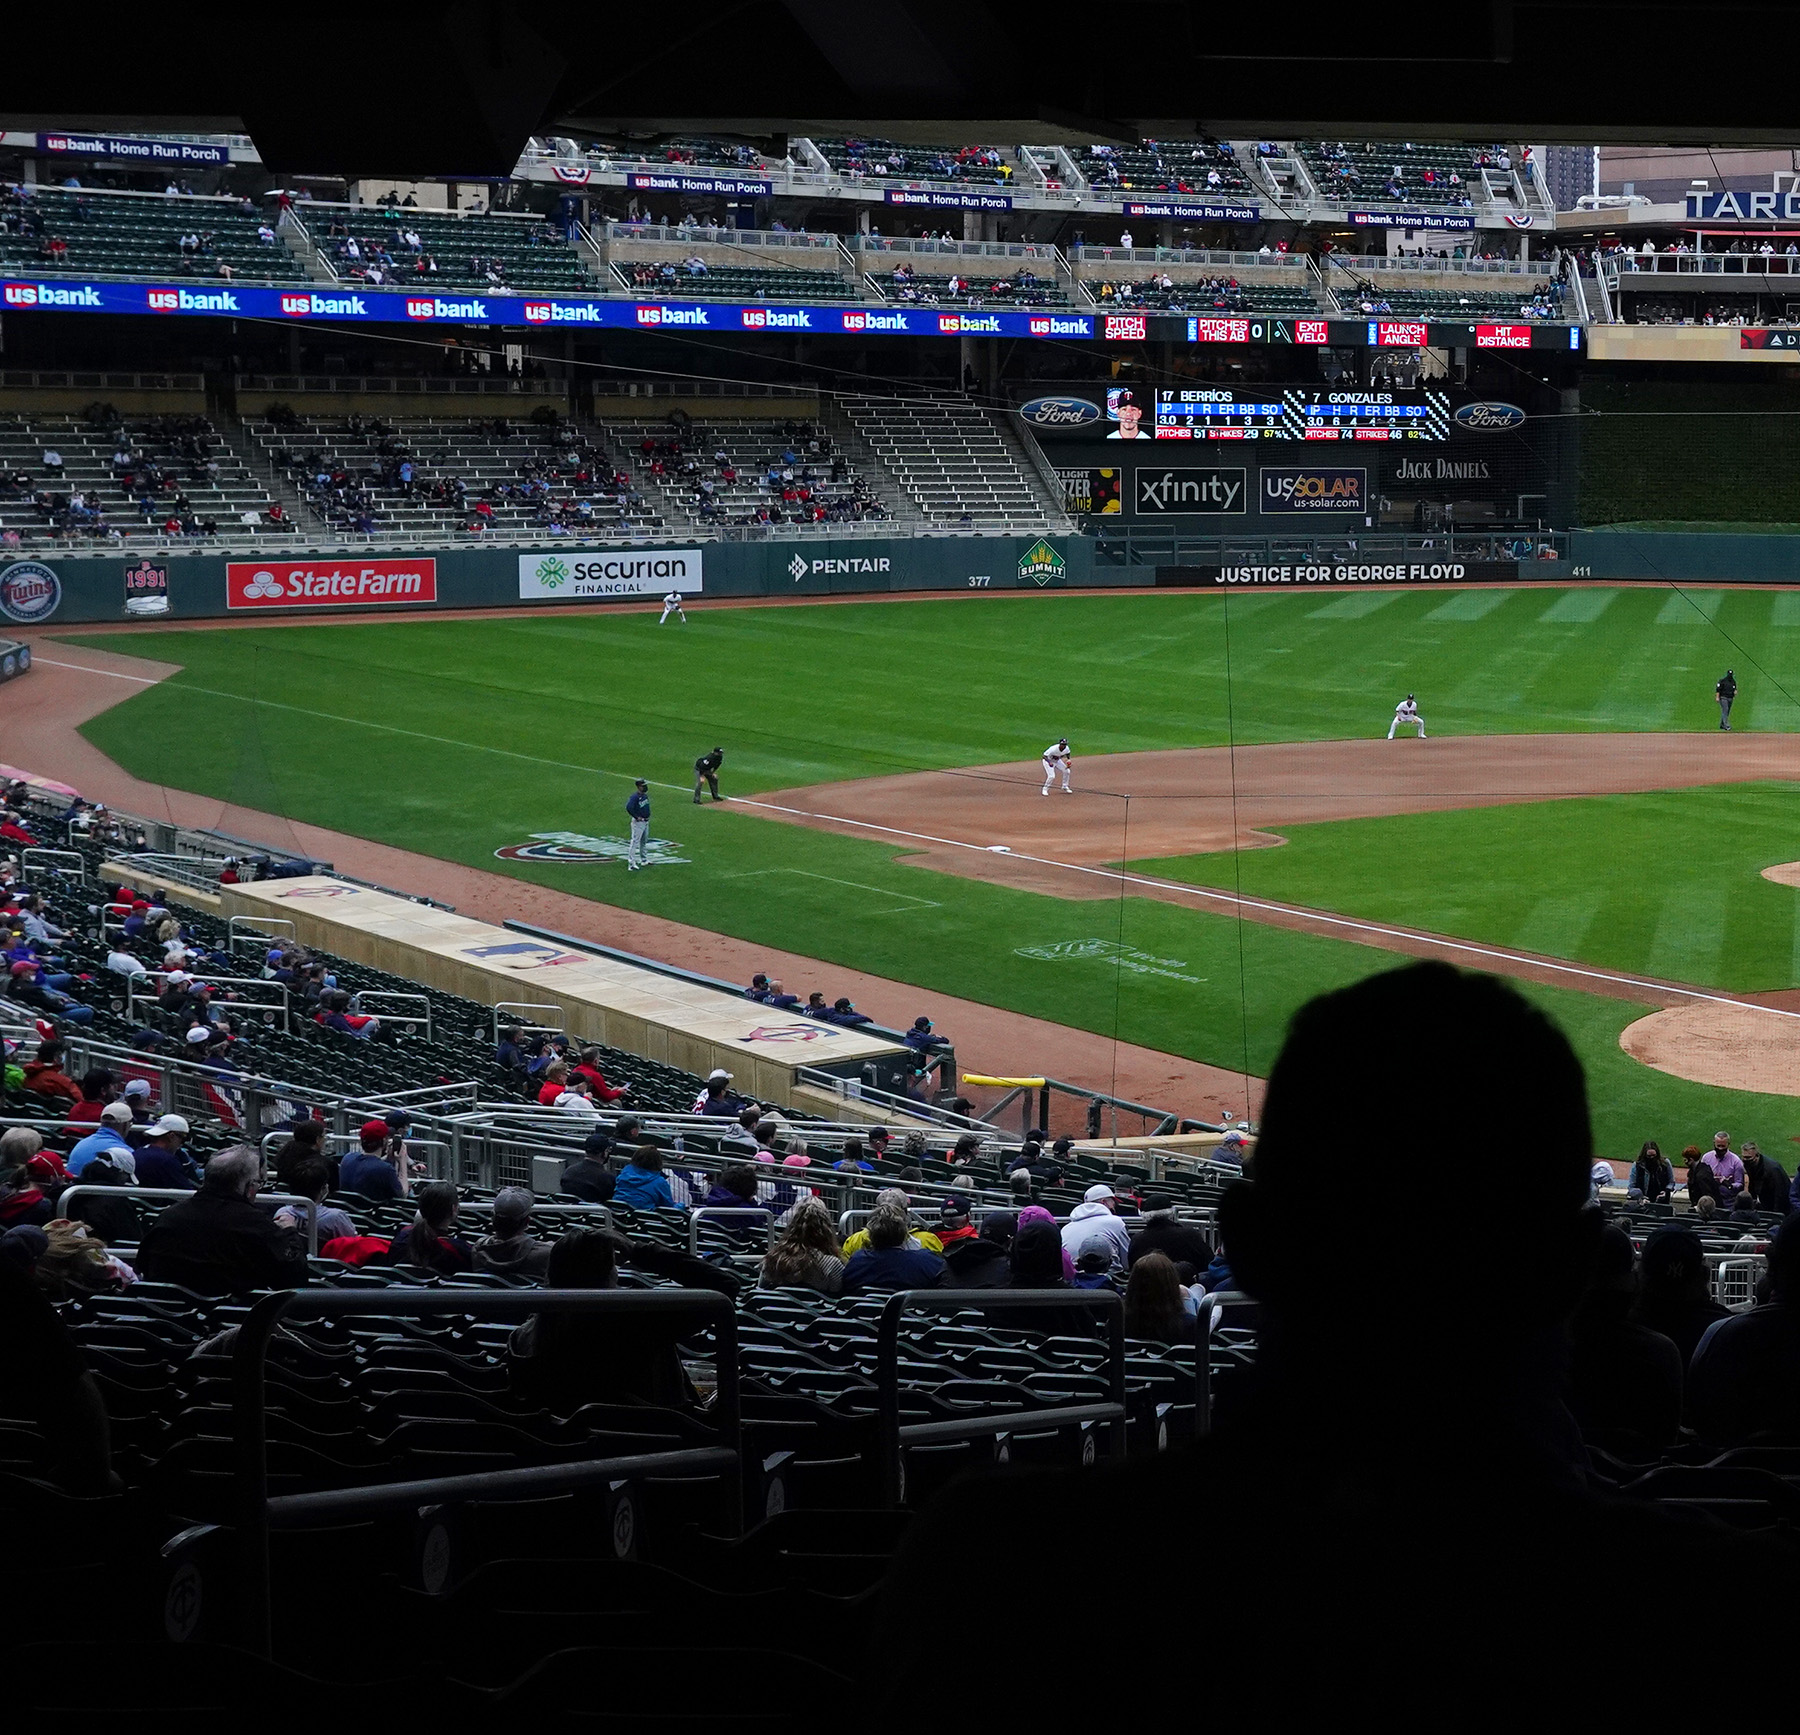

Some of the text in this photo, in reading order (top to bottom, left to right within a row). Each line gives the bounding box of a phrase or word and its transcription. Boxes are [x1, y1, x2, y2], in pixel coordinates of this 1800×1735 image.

[110, 141, 150, 156] Home
[152, 144, 179, 158] Run
[182, 146, 220, 161] Porch
[682, 179, 709, 191] Home
[711, 181, 730, 192] Run
[732, 182, 766, 194] Porch
[932, 195, 959, 206] Home
[961, 196, 977, 207] Run
[980, 197, 1007, 208] Porch
[1174, 207, 1199, 218] Home
[1201, 208, 1219, 219] Run
[1221, 208, 1253, 220] Porch
[1395, 215, 1419, 226] Home
[1422, 216, 1438, 227] Run
[1442, 217, 1470, 229] Porch
[1108, 317, 1144, 328] PITCH
[1200, 319, 1248, 331] PITCHES
[1299, 322, 1324, 332] EXIT
[1105, 328, 1146, 340] SPEED
[1380, 323, 1426, 335] LAUNCH
[1495, 326, 1512, 337] HIT
[1202, 330, 1246, 342] THIS AB
[1297, 332, 1326, 343] VELO
[1384, 335, 1421, 345] ANGLE
[1477, 336, 1530, 347] DISTANCE
[1162, 389, 1233, 402] 17 BERRÍOS
[1329, 393, 1393, 404] GONZALES
[1035, 400, 1086, 424] Ford
[1468, 407, 1512, 428] Ford
[1157, 429, 1191, 438] PITCHES
[1194, 429, 1206, 438] 51
[1244, 429, 1259, 438] 29
[1305, 430, 1402, 440] PITCHES 74 STRIKES 46
[1396, 458, 1490, 479] JACK DANIEL'S
[1061, 471, 1090, 479] LIGHT
[1142, 472, 1241, 510] xfinity
[1294, 497, 1360, 508] us-solar.com
[573, 559, 687, 580] securian
[812, 558, 890, 575] PENTAIR
[1020, 563, 1064, 576] SUMMIT
[1572, 566, 1592, 577] 411
[127, 570, 166, 588] 1991
[1215, 564, 1465, 584] JUSTICE FOR GEORGE FLOYD
[969, 576, 991, 587] 377
[574, 583, 643, 594] FINANCIAL
